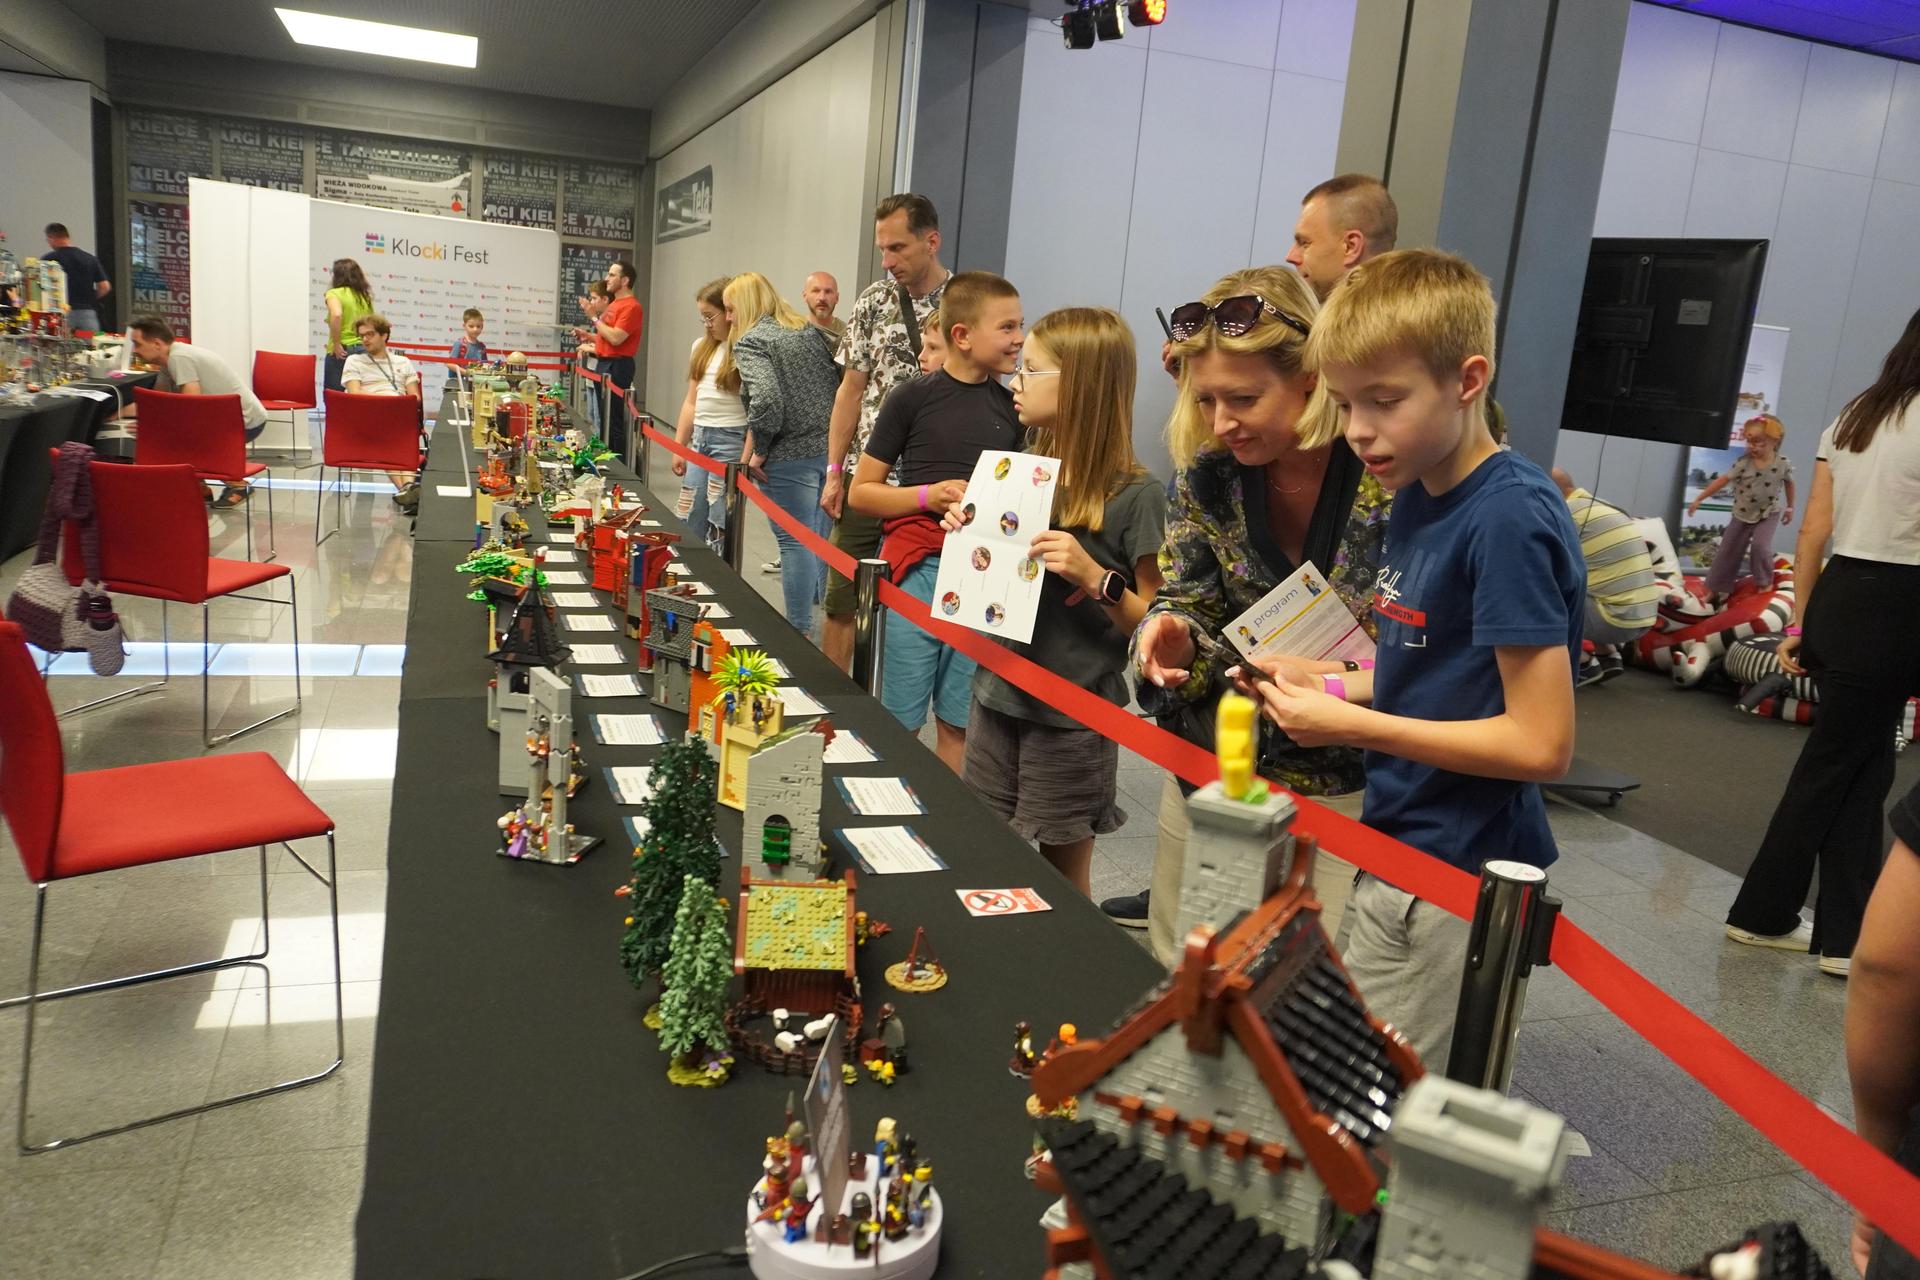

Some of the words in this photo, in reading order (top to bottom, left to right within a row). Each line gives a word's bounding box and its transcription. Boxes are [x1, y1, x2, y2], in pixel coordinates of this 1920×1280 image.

[206, 126, 260, 146] ARGI
[129, 165, 198, 184] KIELC
[587, 171, 633, 188] TARGI
[348, 182, 387, 191] WIDOKOWA
[584, 214, 631, 231] TARGI
[562, 226, 599, 237] KIELCE
[602, 230, 632, 240] TARGI
[392, 237, 447, 260] Klocki
[453, 245, 489, 265] Fest
[1252, 587, 1299, 628] program
